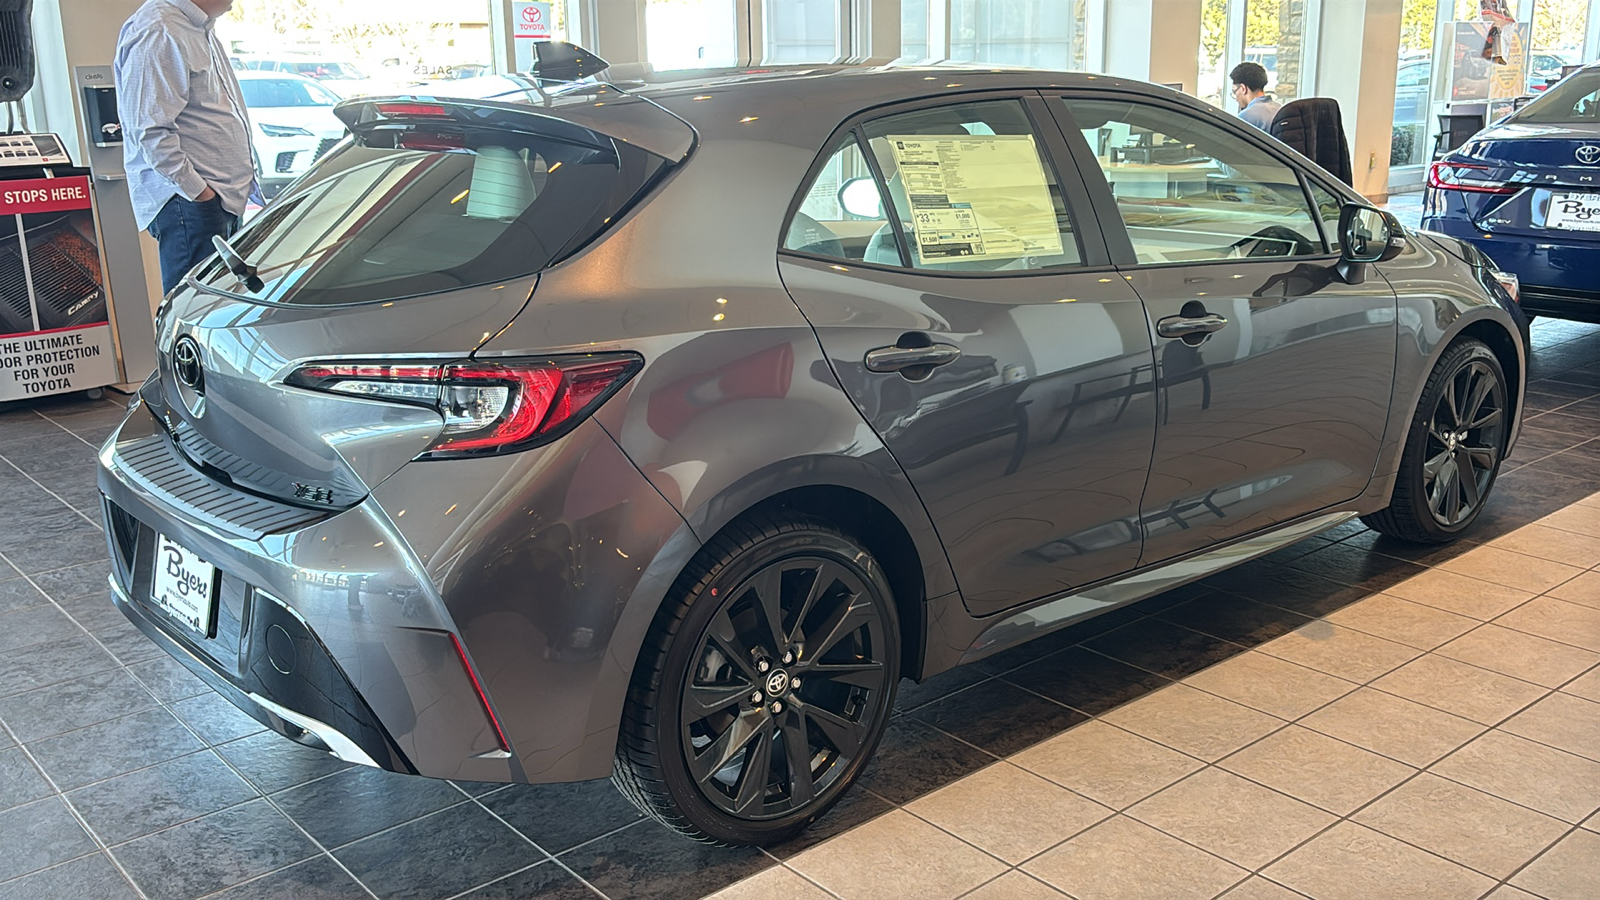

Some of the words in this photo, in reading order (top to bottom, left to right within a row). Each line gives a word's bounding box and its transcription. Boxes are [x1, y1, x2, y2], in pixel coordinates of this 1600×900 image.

[519, 23, 545, 31] TOYOTA
[4, 189, 48, 204] STOPS
[51, 186, 86, 201] HERE.
[919, 213, 930, 223] 33
[68, 291, 99, 316] CAMRY
[24, 334, 83, 352] ULTIMATE
[26, 345, 100, 366] PROTECTION
[14, 368, 39, 381] FOR
[42, 363, 75, 378] YOUR
[23, 378, 71, 394] TOYOTA
[163, 545, 207, 599] Byers
